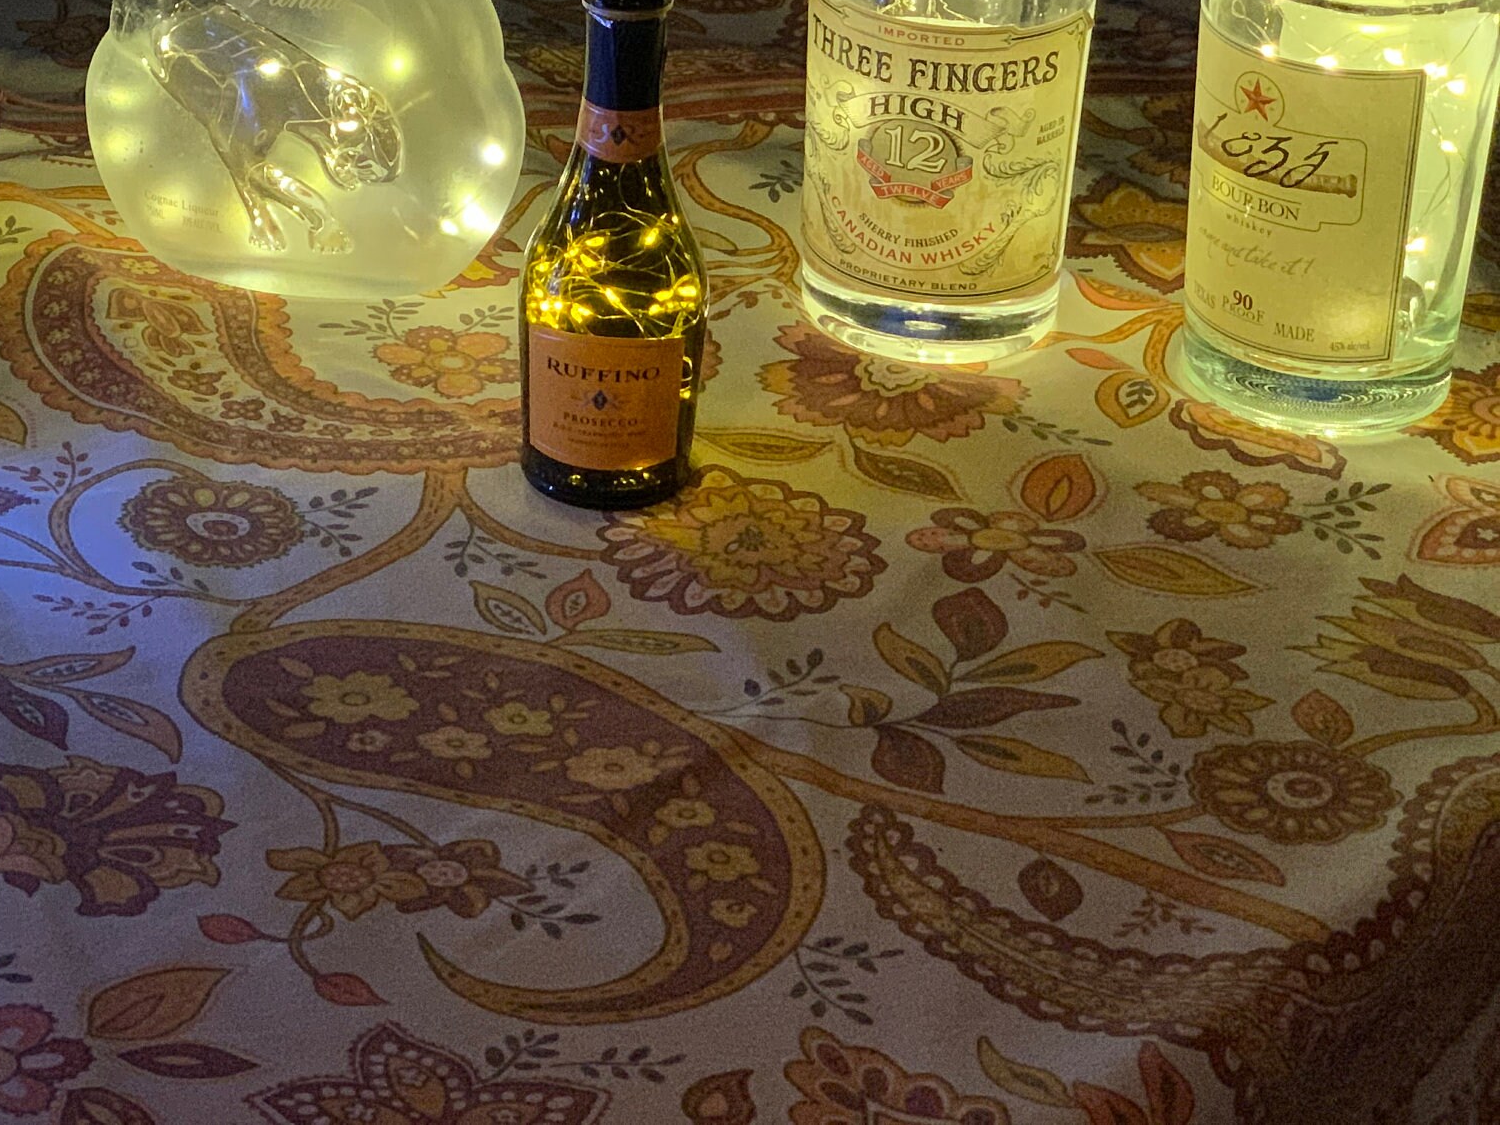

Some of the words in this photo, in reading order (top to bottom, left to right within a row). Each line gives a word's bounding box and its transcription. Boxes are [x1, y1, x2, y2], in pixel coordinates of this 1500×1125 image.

[878, 25, 966, 47] IMPORTED
[813, 13, 894, 84] THREE
[907, 50, 1060, 94] FINGERS
[868, 93, 966, 134] HIGH
[885, 125, 949, 174] 12
[860, 156, 885, 178] AGED
[935, 172, 969, 189] YEARS
[880, 185, 938, 204] TWELVE
[1211, 174, 1301, 222] BOURBON
[831, 195, 913, 265] CANADIAN
[920, 221, 997, 266] WHISKY
[859, 212, 902, 245] SHERRY
[904, 228, 960, 249] FINISHED
[839, 258, 926, 289] PROPRIETARY
[931, 281, 979, 292] BLEND
[1221, 294, 1266, 323] PROOF
[1232, 289, 1254, 312] 90
[1272, 322, 1316, 343] MADE
[546, 356, 661, 384] RUFFINO
[563, 411, 639, 428] PROSECCO
